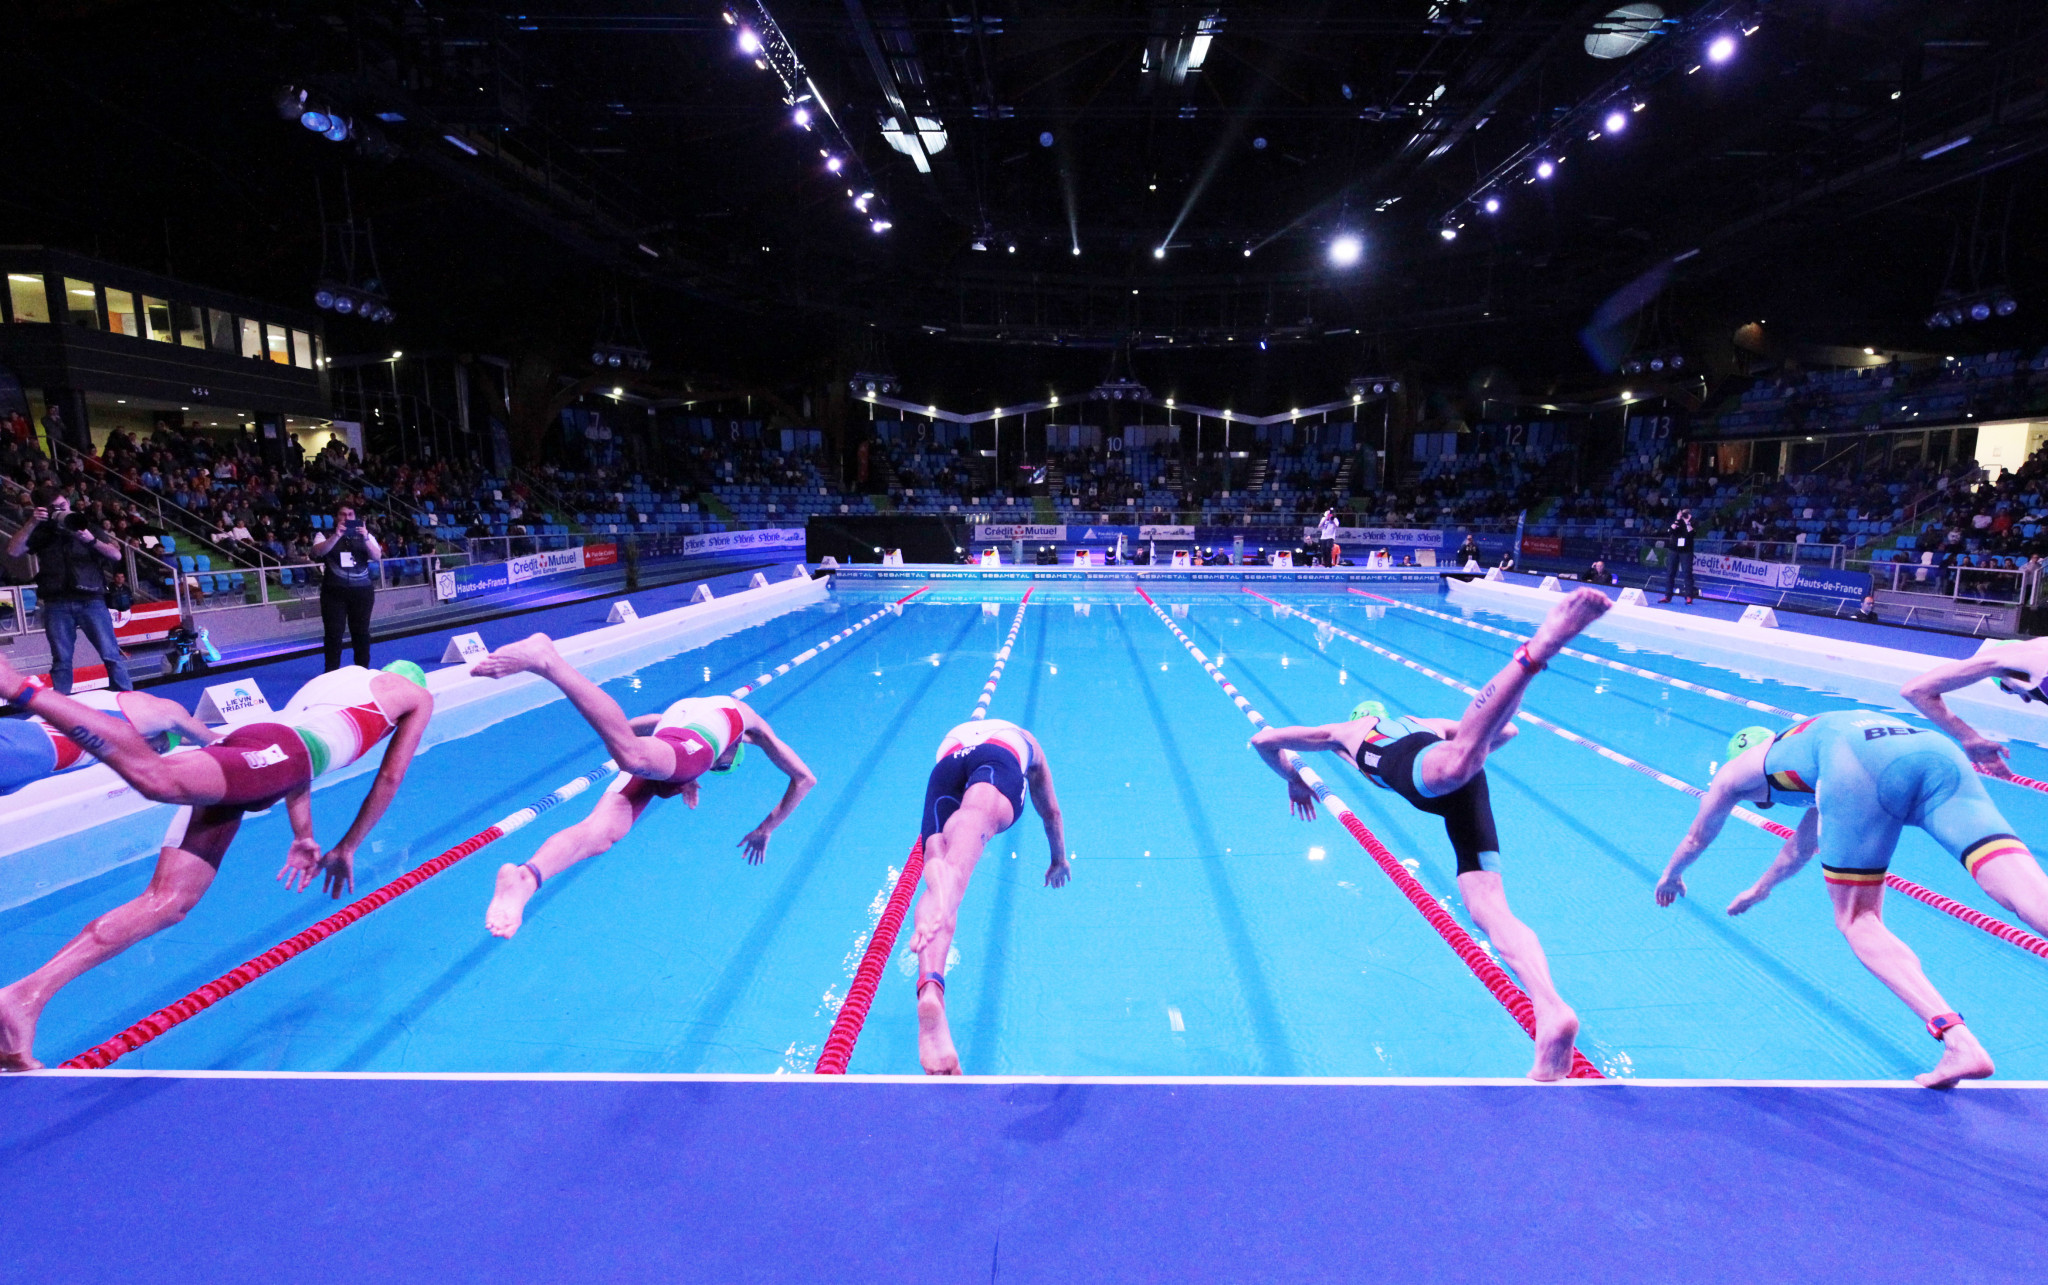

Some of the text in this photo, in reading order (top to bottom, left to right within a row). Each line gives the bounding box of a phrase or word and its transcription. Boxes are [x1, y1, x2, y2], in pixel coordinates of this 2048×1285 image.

[917, 422, 926, 442] 9
[1303, 425, 1318, 444] 11
[1505, 424, 1523, 446] 12
[1650, 416, 1670, 440] 13
[1107, 436, 1122, 452] 10
[984, 526, 1057, 536] Crédit Mutuel
[513, 551, 577, 575] Crédit Mutuel
[1731, 560, 1768, 577] Mutuel
[456, 577, 508, 594] Hauts-de-France
[1795, 577, 1863, 595] Hauts-de-France
[221, 698, 265, 713] TRIATHLON
[225, 695, 252, 707] LIEVIN
[1736, 733, 1748, 749] 3
[1863, 726, 1929, 741] BEL
